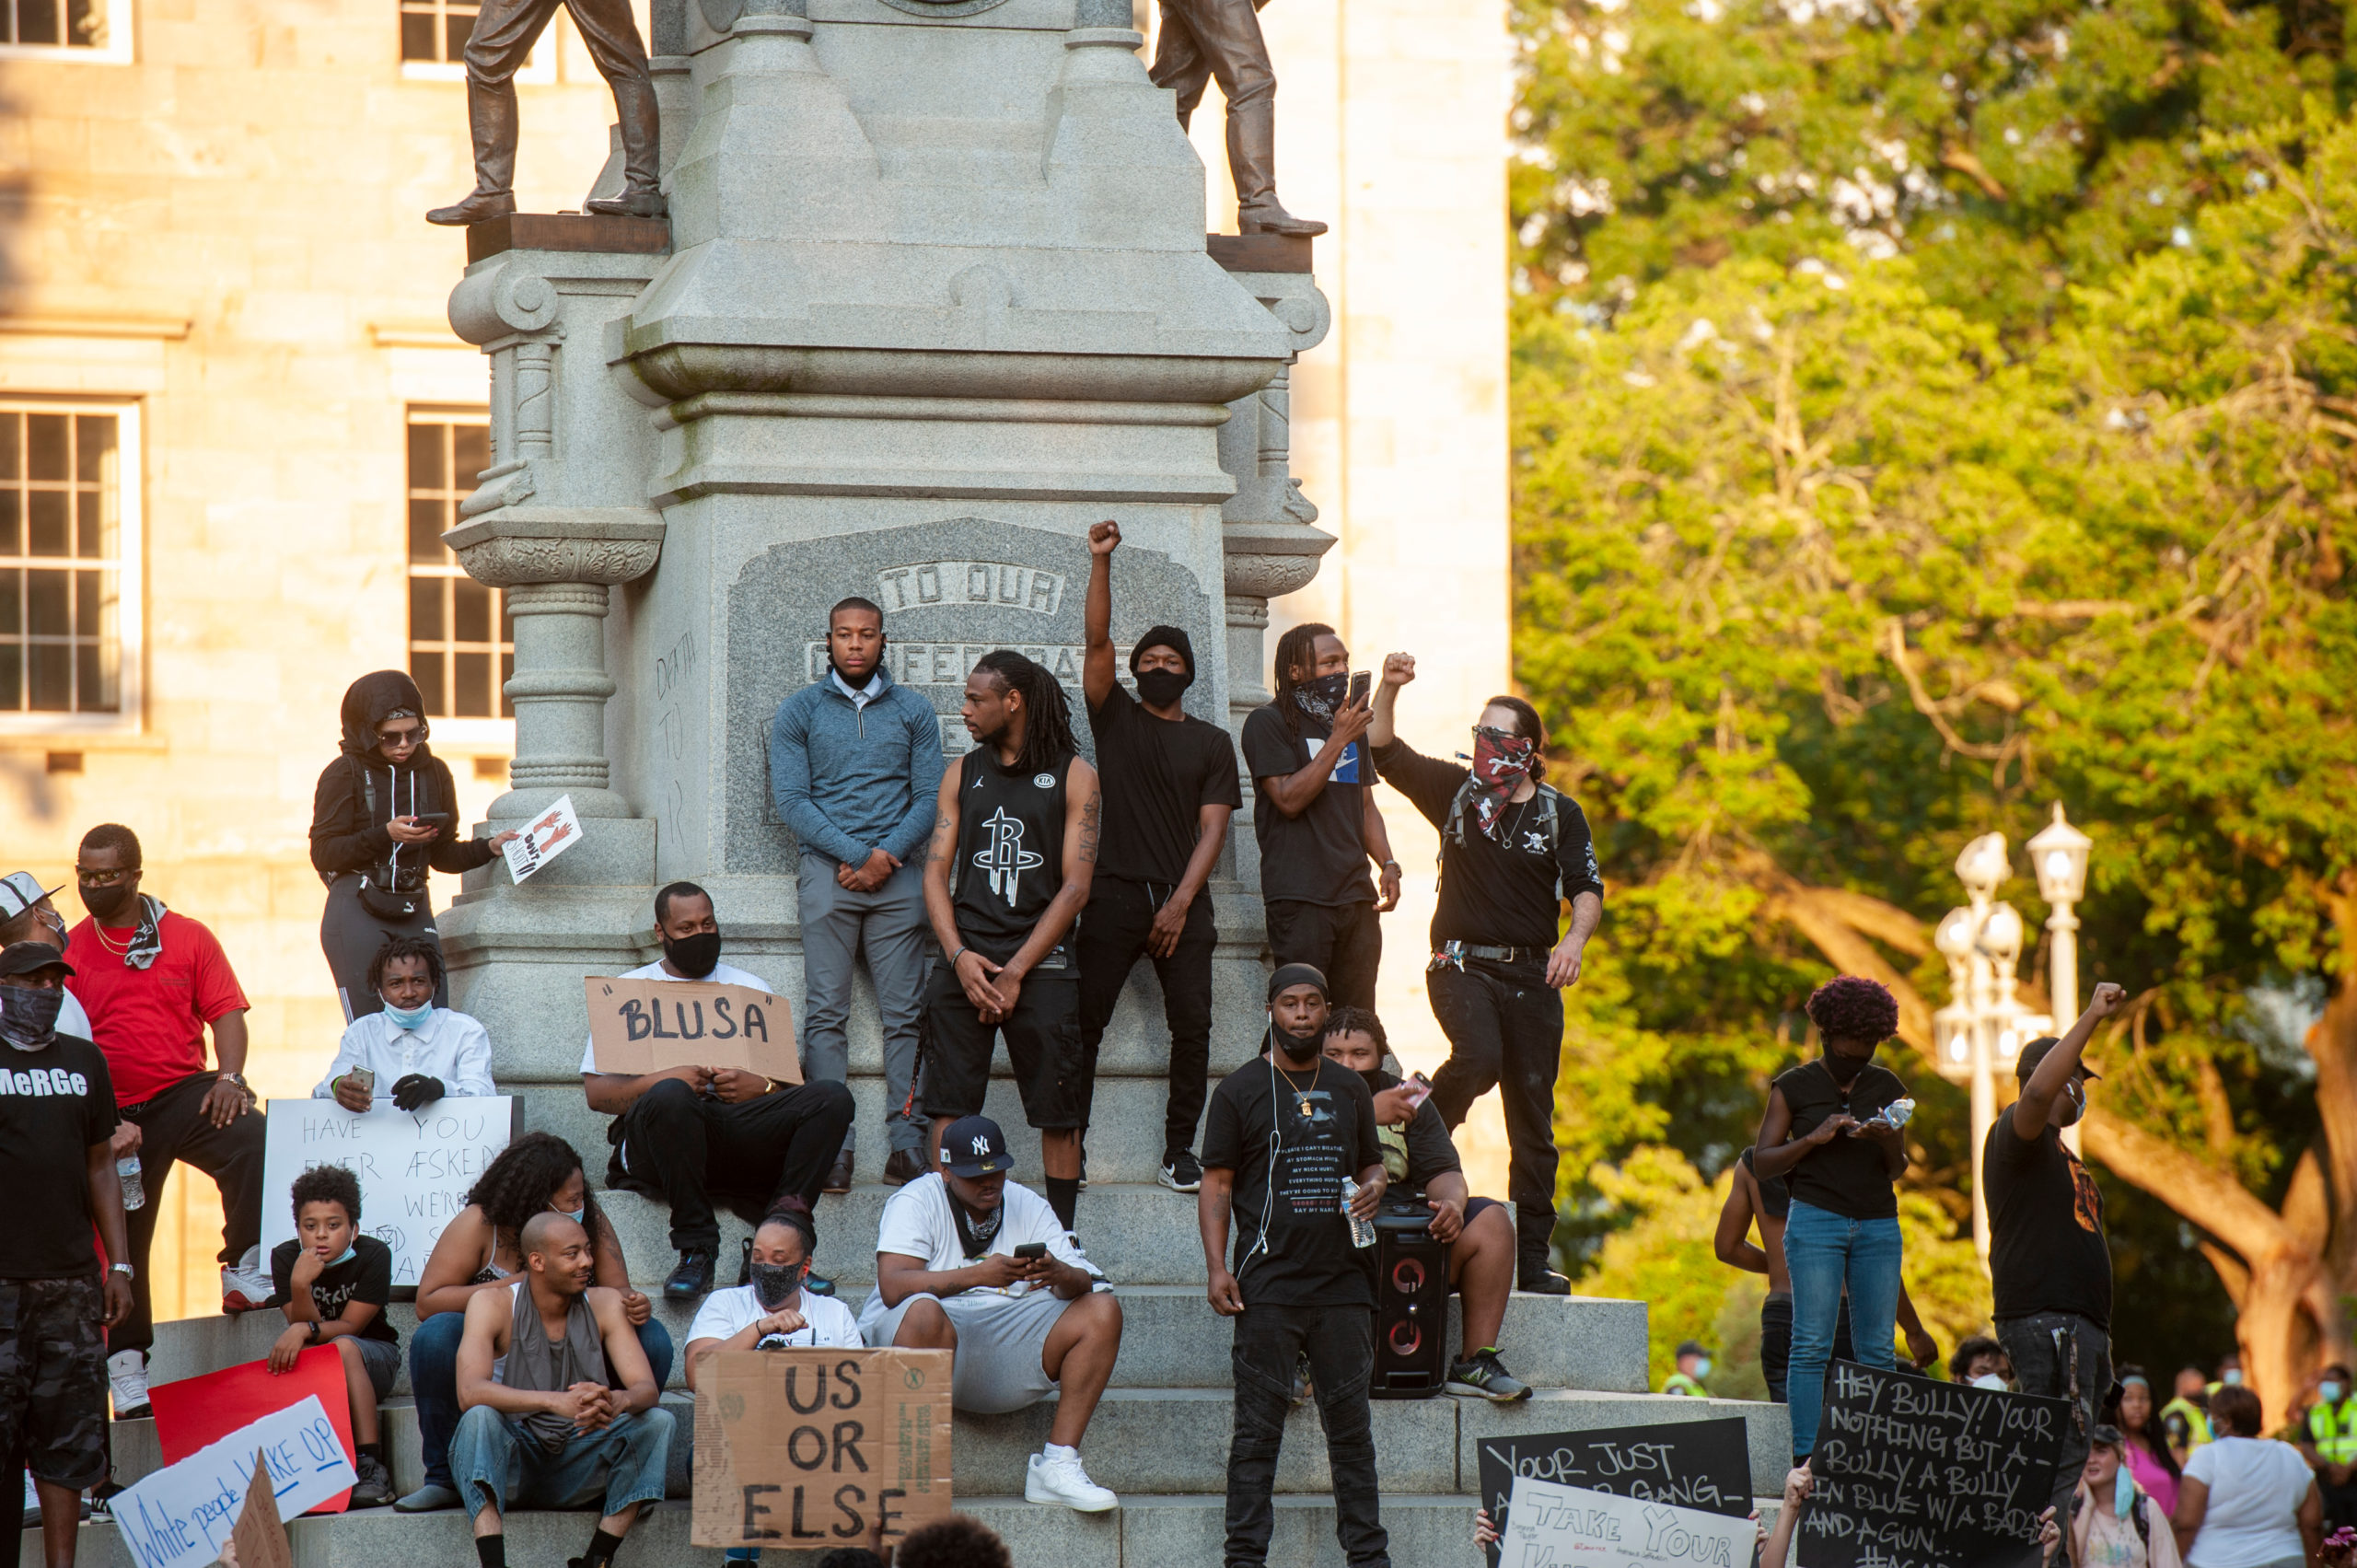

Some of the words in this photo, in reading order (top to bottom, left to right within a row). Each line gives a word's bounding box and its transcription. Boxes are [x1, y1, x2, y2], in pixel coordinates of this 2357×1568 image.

[883, 564, 943, 609] TO
[967, 563, 1054, 614] OUR
[658, 702, 683, 761] TO
[1038, 776, 1051, 784] KIA
[303, 1117, 362, 1144] HAVE
[413, 1115, 484, 1142] YOU
[971, 1134, 991, 1156] NY
[785, 1360, 861, 1414] US
[1835, 1365, 1886, 1413] HEY
[1997, 1397, 2054, 1442] YOUR
[299, 1417, 338, 1462] UP
[788, 1420, 868, 1473] OR
[1486, 1444, 1587, 1483] YOUR
[1588, 1442, 1675, 1481] JUST
[1830, 1406, 1947, 1458] NOTHING
[1953, 1434, 2002, 1473] BUT
[1807, 1476, 1843, 1504] IN
[1852, 1483, 1921, 1515] BLUE
[1919, 1461, 1938, 1489] A
[1945, 1466, 2021, 1511] BULLY
[118, 1493, 195, 1568] White
[743, 1484, 906, 1540] ELSE
[1527, 1492, 1621, 1542] TAKE
[1643, 1504, 1732, 1567] YOUR
[1805, 1508, 1853, 1538] AND
